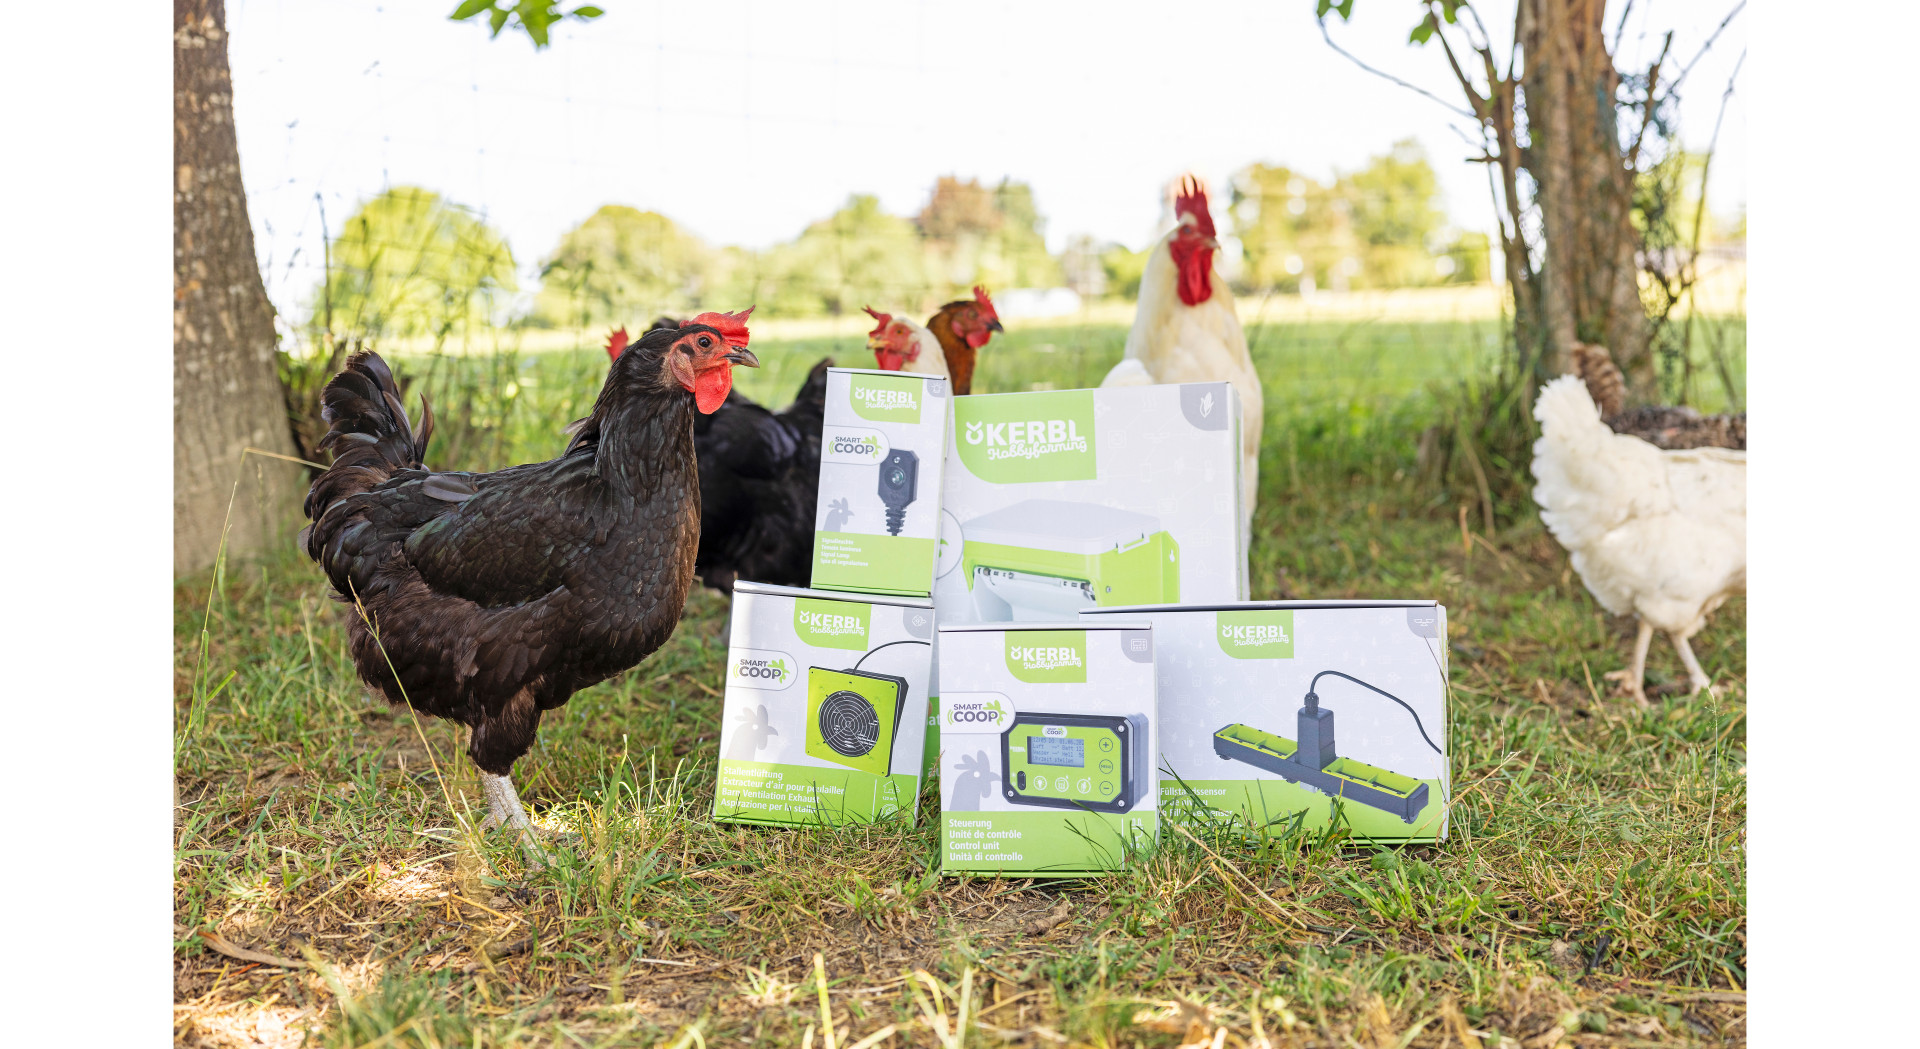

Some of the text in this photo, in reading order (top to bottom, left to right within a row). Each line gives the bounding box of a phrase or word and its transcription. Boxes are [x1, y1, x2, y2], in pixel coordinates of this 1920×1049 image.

[866, 389, 916, 404] KERBL
[865, 401, 917, 410] Hobbyfarming
[986, 419, 1085, 446] KERBL
[835, 436, 861, 444] SMART
[834, 443, 874, 454] COOP
[987, 439, 1087, 460] Hobbyfarming
[811, 613, 864, 629] KERBL
[810, 626, 864, 636] Hobbyfarming
[1234, 625, 1288, 638] KERBL
[1234, 636, 1289, 646] Hobbyfarming
[1023, 648, 1080, 661] KERBL
[740, 659, 768, 667] SMART
[1024, 658, 1082, 670] Hobbyfarming
[739, 666, 782, 679] COOP
[954, 711, 998, 722] COOP
[724, 766, 783, 780] Stallentlüftung
[723, 777, 763, 788] Extracteur
[786, 784, 807, 792] pour
[722, 788, 740, 796] Barn
[743, 789, 786, 800] Ventilation
[949, 819, 992, 830] Steuerung
[950, 830, 1022, 838] Unité de contrôle
[950, 841, 1000, 850] Control unit
[950, 852, 1022, 861] Unità di controllo
